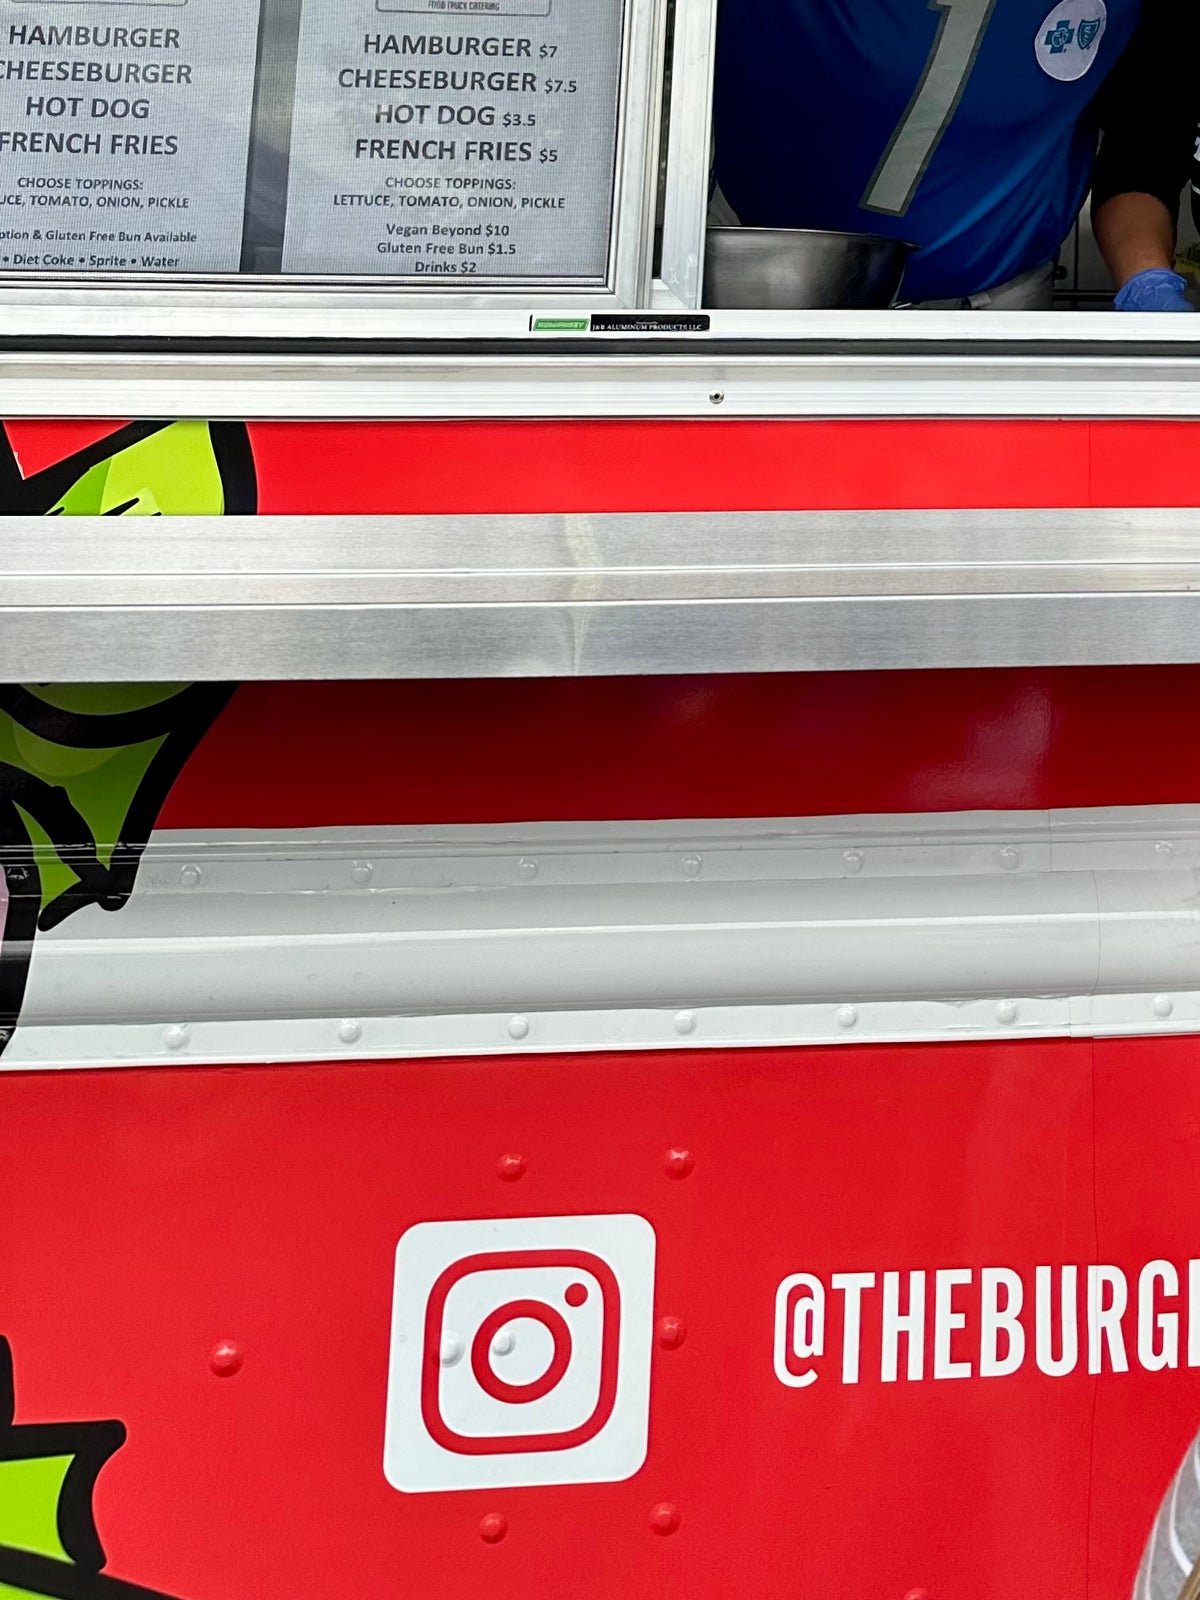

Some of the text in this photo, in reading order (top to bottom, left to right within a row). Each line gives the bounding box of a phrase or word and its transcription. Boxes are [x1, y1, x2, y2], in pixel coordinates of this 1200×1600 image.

[9, 25, 180, 48] HAMBURGER
[363, 34, 558, 59] HAMBURGER $7
[338, 68, 578, 94] CHEESEBURGER $7.5
[26, 96, 150, 119] HOT DOG
[375, 104, 536, 128] HOT DOG $3.5
[0, 131, 178, 155] FRENCH FRIES
[355, 139, 558, 164] FRENCH FRIES $5
[17, 177, 144, 190] CHOOSE TOPPINGS:
[385, 177, 516, 190] CHOOSE TOPPINGS:
[30, 195, 93, 209] TOMATO,
[96, 196, 144, 209] ONION,
[148, 197, 190, 208] PICKLE
[333, 194, 566, 210] LETTUCE, TOMATO, ONION, PICKLE
[32, 230, 42, 241] &
[45, 230, 86, 241] Gluten
[89, 231, 115, 242] Free
[118, 231, 141, 242] Bun
[144, 231, 197, 243] Available
[386, 224, 510, 238] Vegan Beyond $10
[377, 242, 517, 256] Gluten Free Bun $1.5
[13, 254, 180, 269] Diet Coke Sprite Water
[415, 261, 477, 274] Drinks $2
